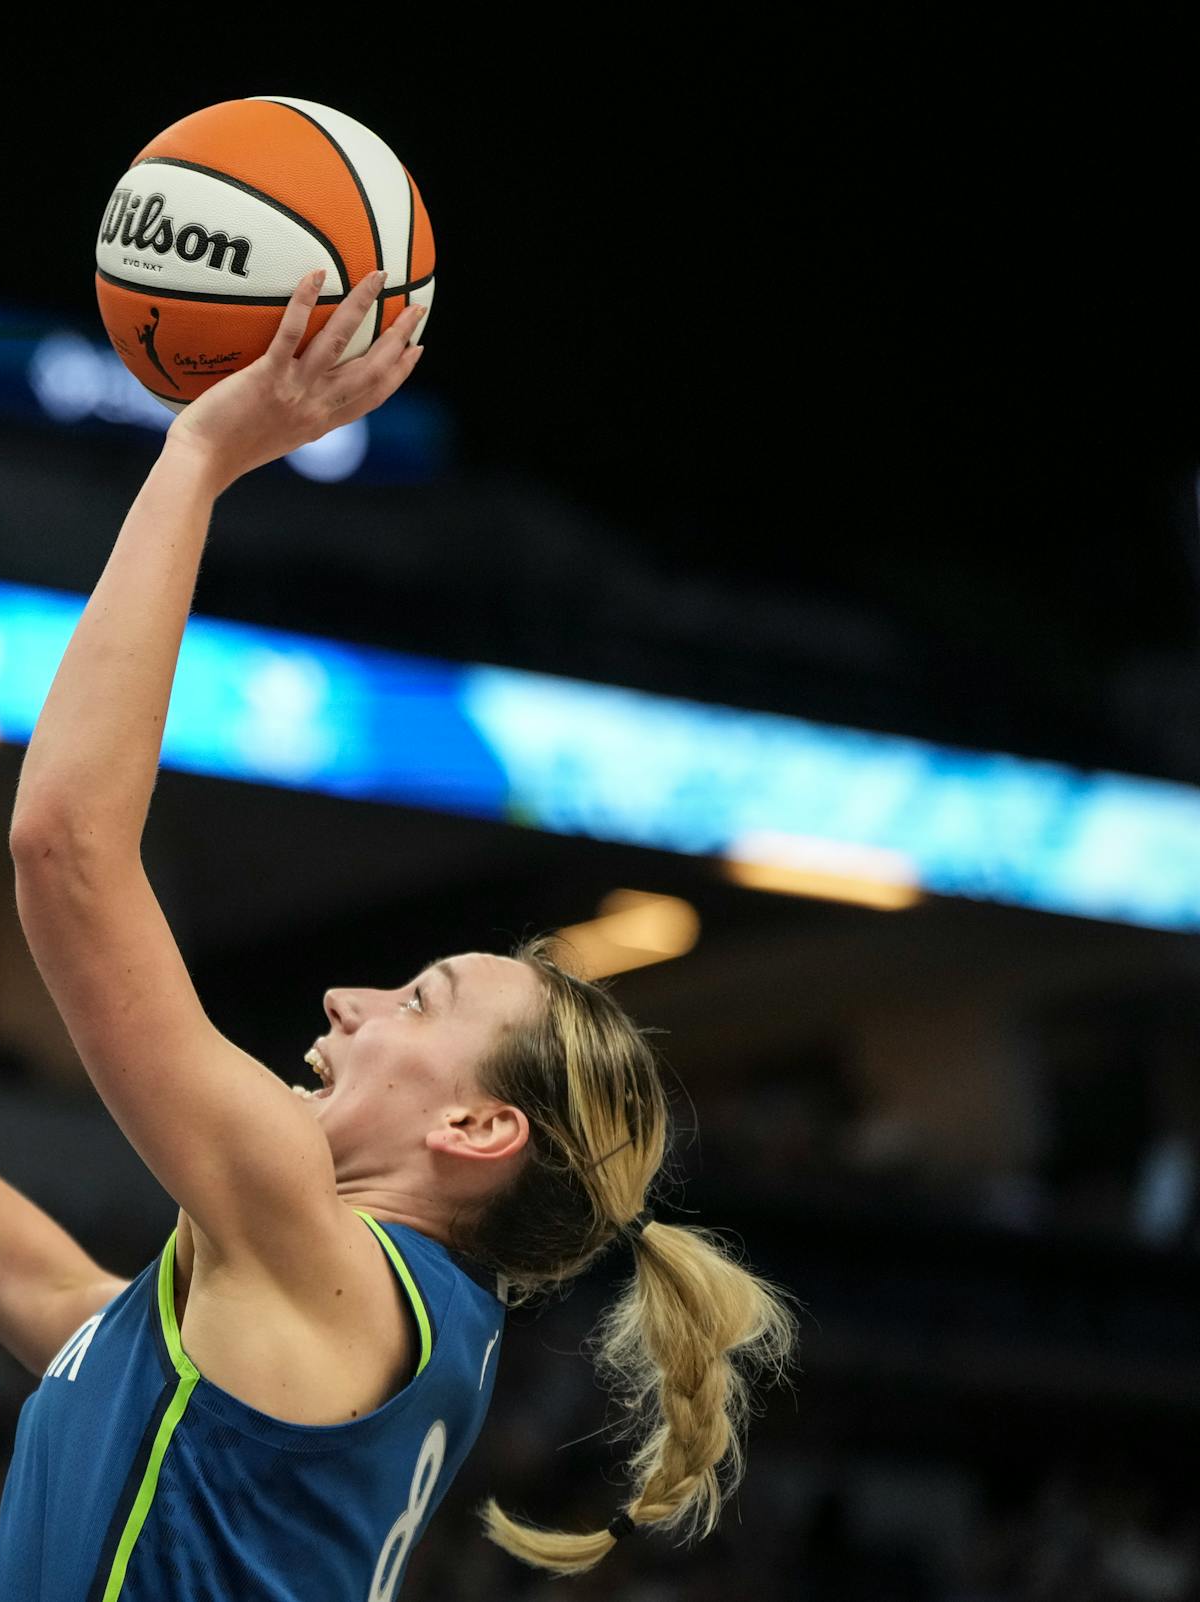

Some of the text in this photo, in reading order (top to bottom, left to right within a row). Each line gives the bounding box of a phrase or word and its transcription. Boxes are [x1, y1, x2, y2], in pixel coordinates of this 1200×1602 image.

[123, 257, 164, 272] EVO NXT
[368, 1419, 447, 1602] 8
